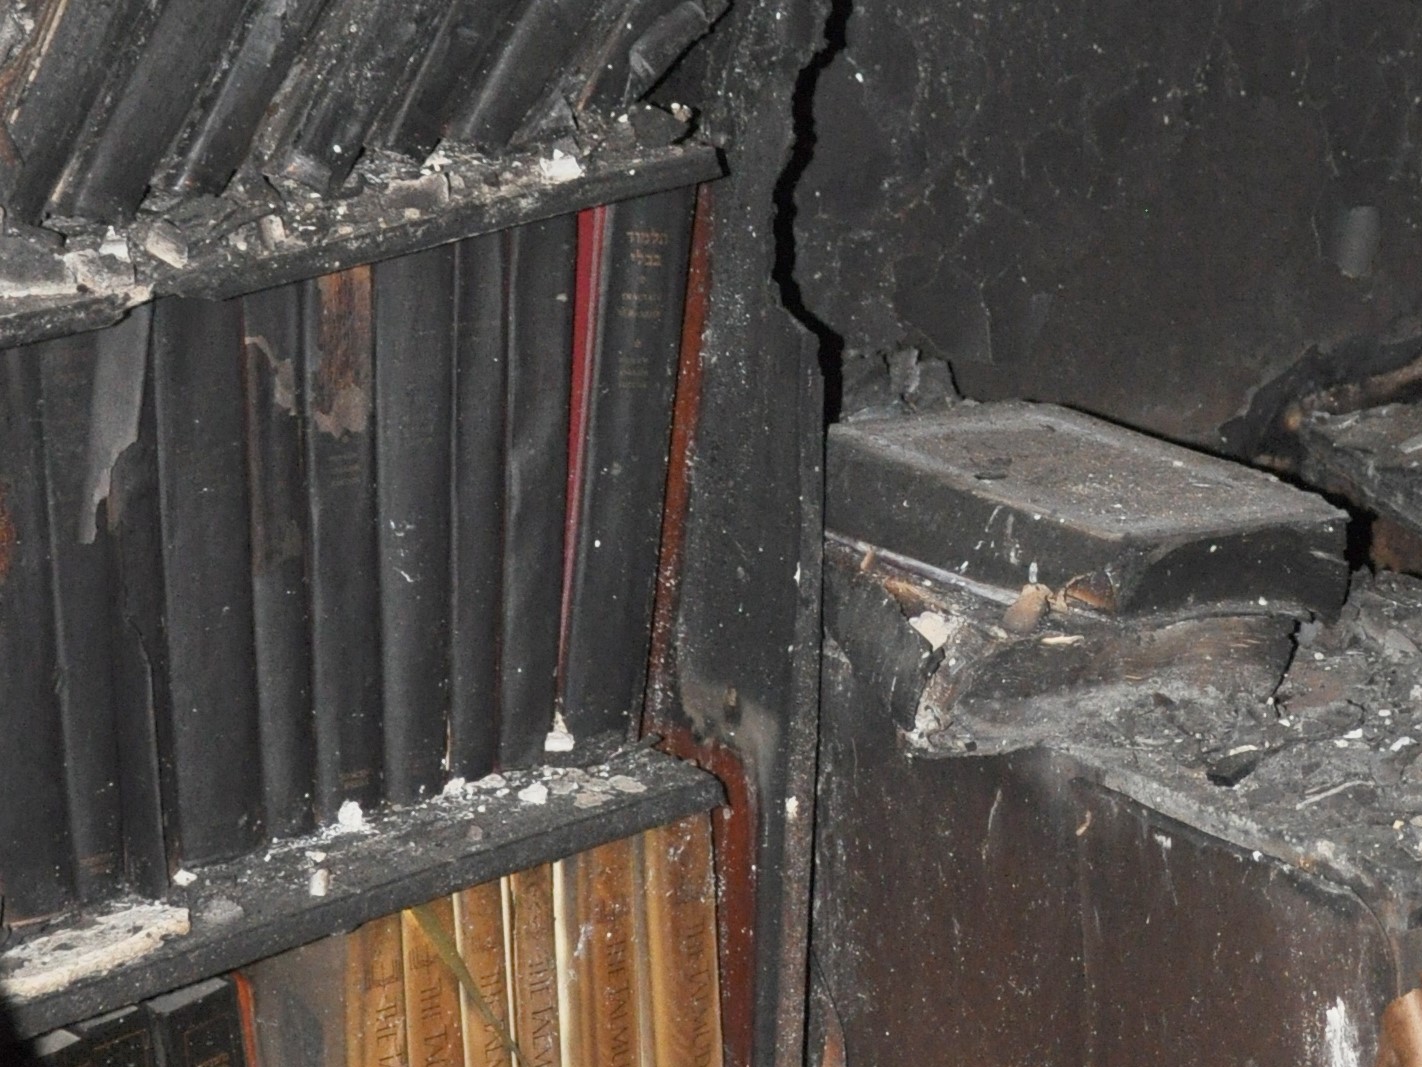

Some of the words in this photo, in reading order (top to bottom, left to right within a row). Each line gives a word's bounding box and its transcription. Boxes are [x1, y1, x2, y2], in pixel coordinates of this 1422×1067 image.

[626, 229, 668, 245] תלמוד
[630, 249, 662, 267] בבלי
[607, 936, 627, 983] THE
[421, 979, 443, 1024] THE
[529, 961, 551, 1001] THE
[375, 1004, 398, 1046] THE
